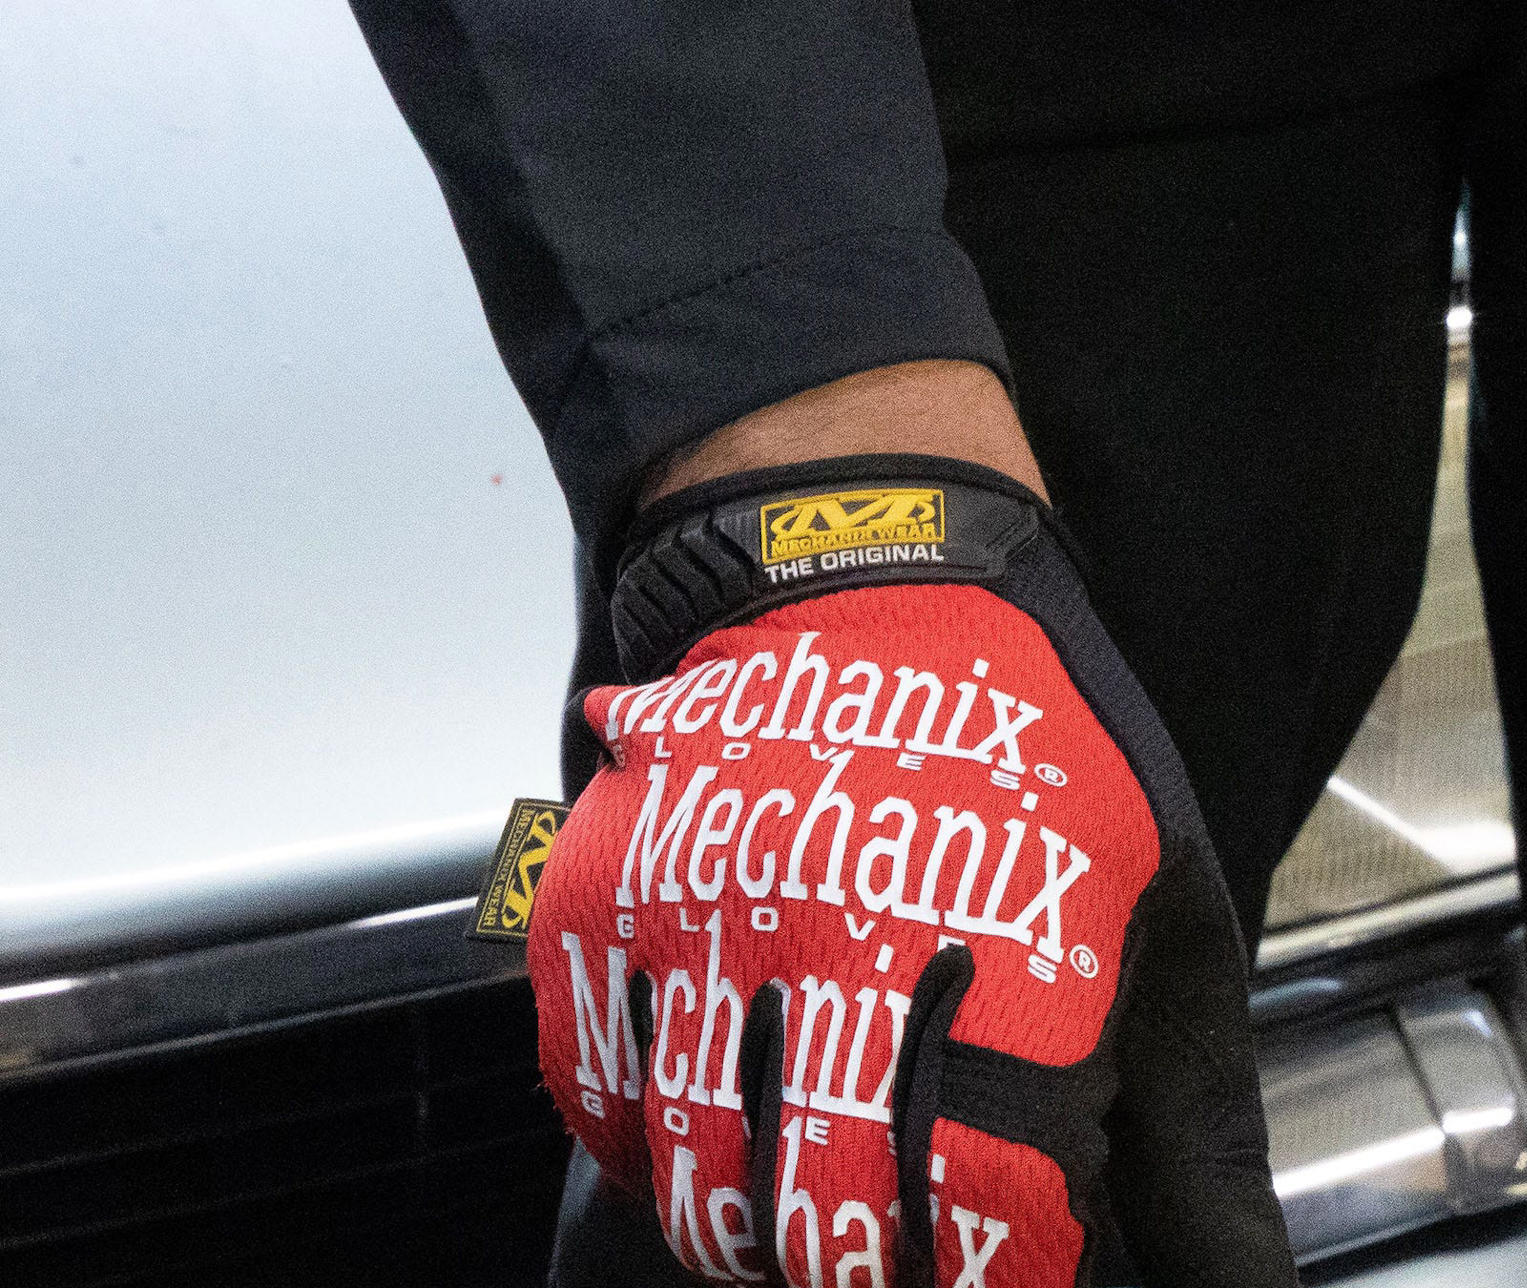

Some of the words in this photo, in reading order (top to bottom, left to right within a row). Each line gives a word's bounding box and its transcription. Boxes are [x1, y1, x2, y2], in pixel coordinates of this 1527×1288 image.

[771, 532, 878, 558] MECHANIX
[879, 522, 936, 541] WEAR
[765, 557, 814, 584] THE
[821, 543, 944, 571] ORIGINAL
[484, 884, 504, 926] WEAR
